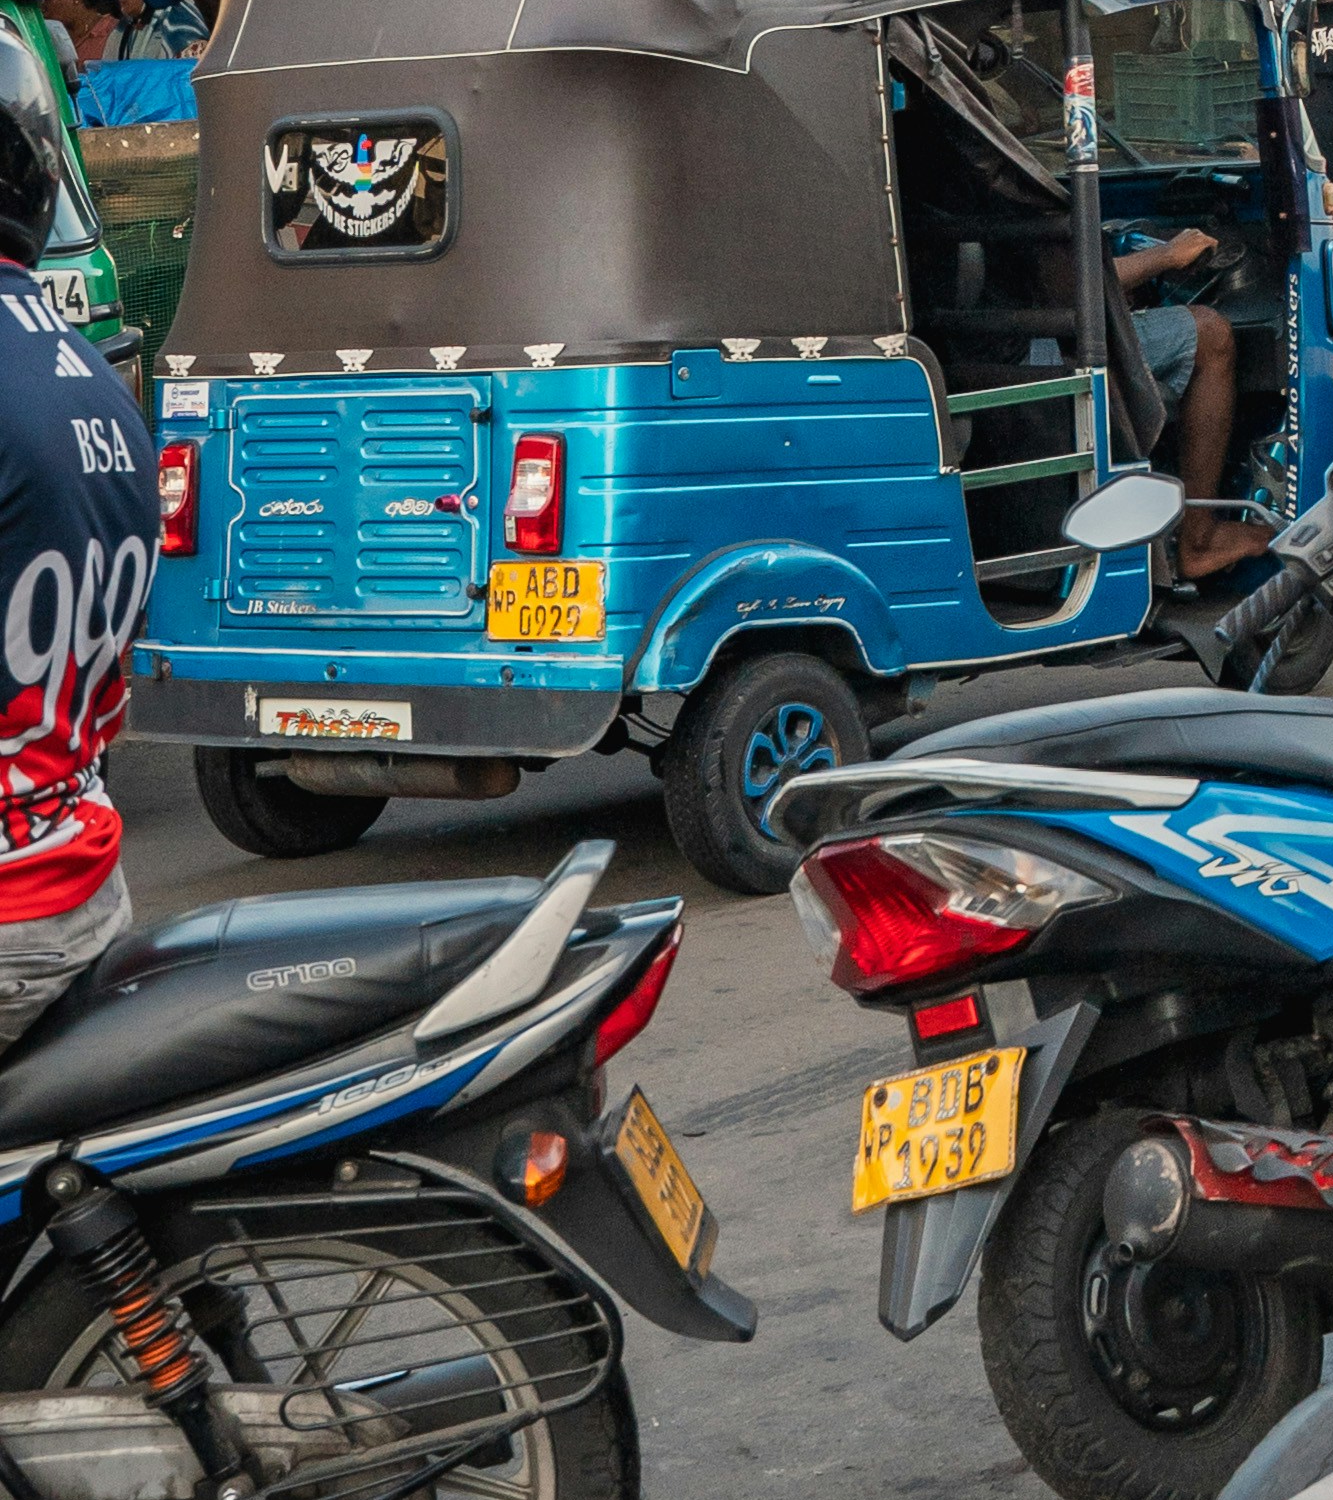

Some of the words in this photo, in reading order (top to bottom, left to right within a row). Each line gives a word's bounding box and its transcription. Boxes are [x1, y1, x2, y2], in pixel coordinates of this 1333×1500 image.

[346, 204, 395, 238] STICKERS
[1287, 273, 1299, 379] Stickers
[1287, 387, 1299, 452] Auto
[525, 566, 580, 598] ABD
[266, 600, 317, 615] Stickers
[494, 590, 516, 613] WP
[519, 604, 581, 637] 0929
[247, 957, 356, 991] CT100
[908, 1062, 986, 1129] BDB
[864, 1123, 893, 1164] WP
[893, 1121, 987, 1191] 1939
